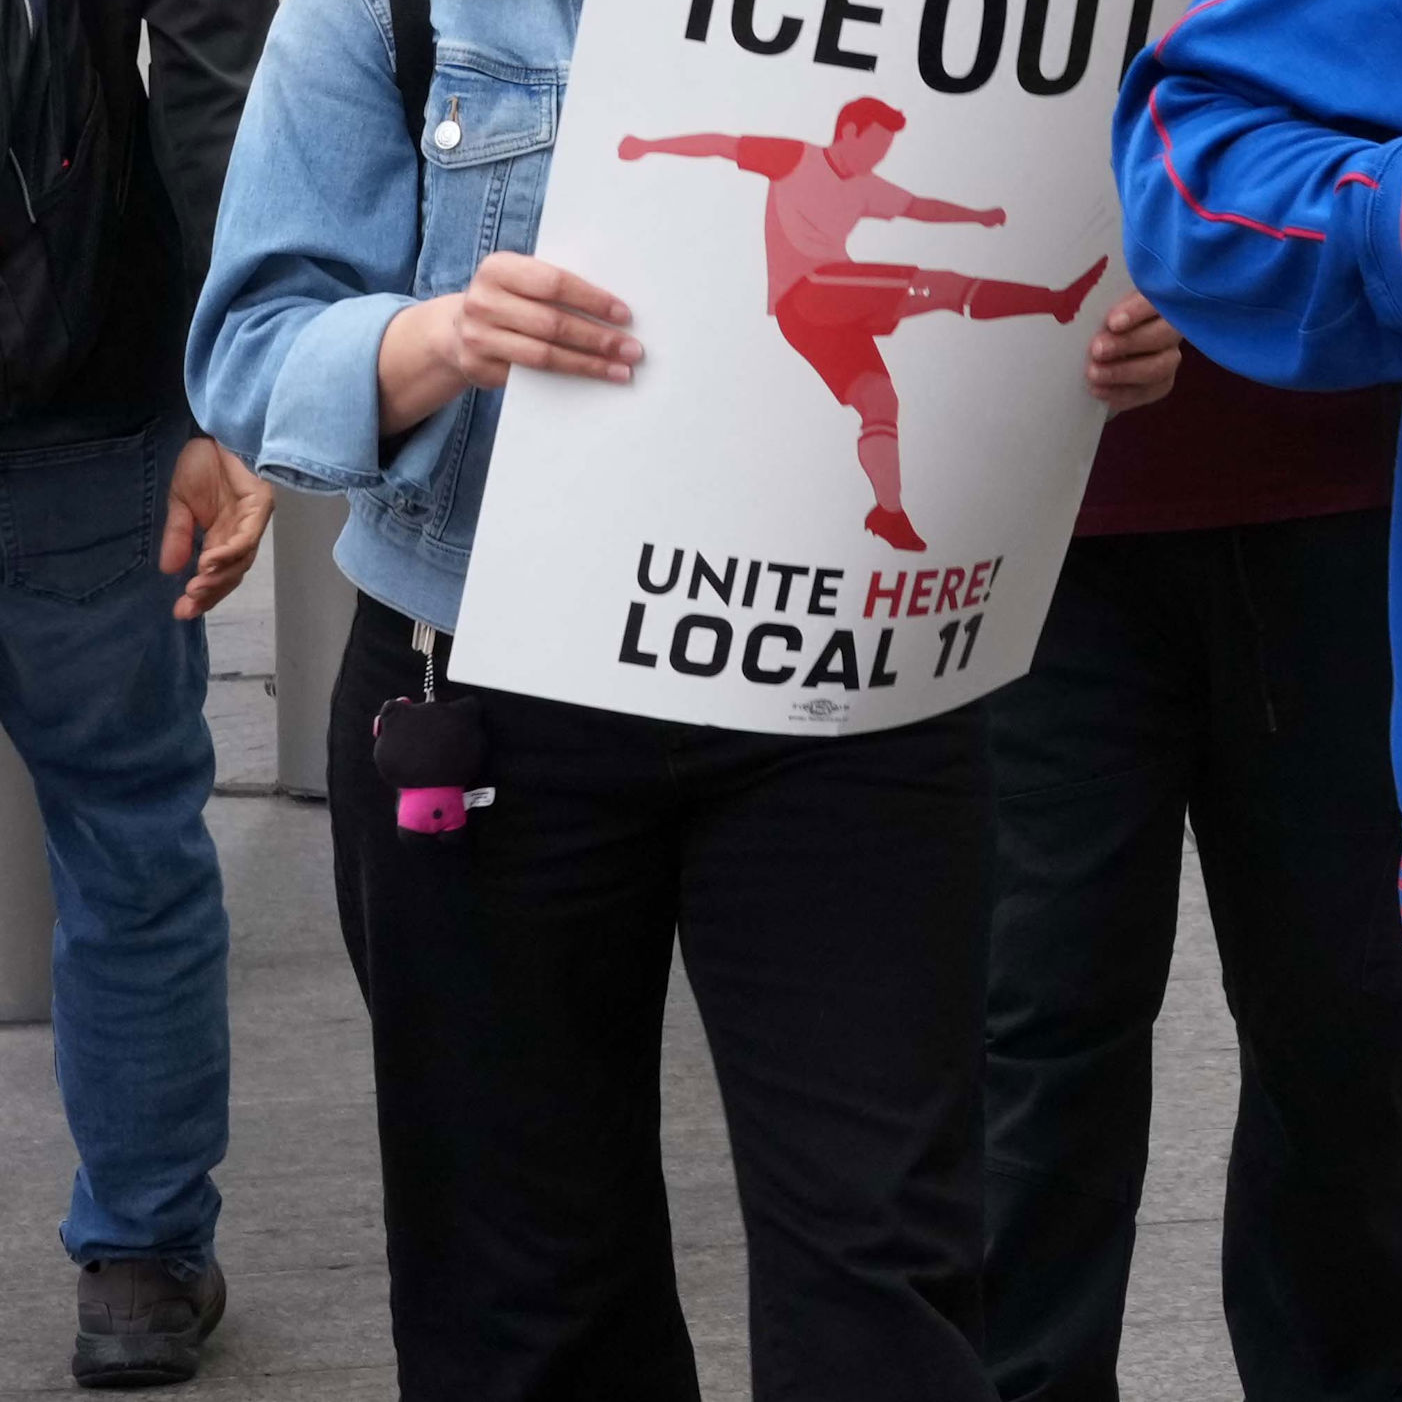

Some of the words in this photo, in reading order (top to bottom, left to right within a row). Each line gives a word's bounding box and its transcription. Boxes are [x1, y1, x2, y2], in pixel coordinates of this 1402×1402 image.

[636, 542, 845, 617] UNITE
[862, 555, 1004, 620] HERE!
[618, 601, 898, 691] LOCAL
[933, 612, 985, 679] 11
